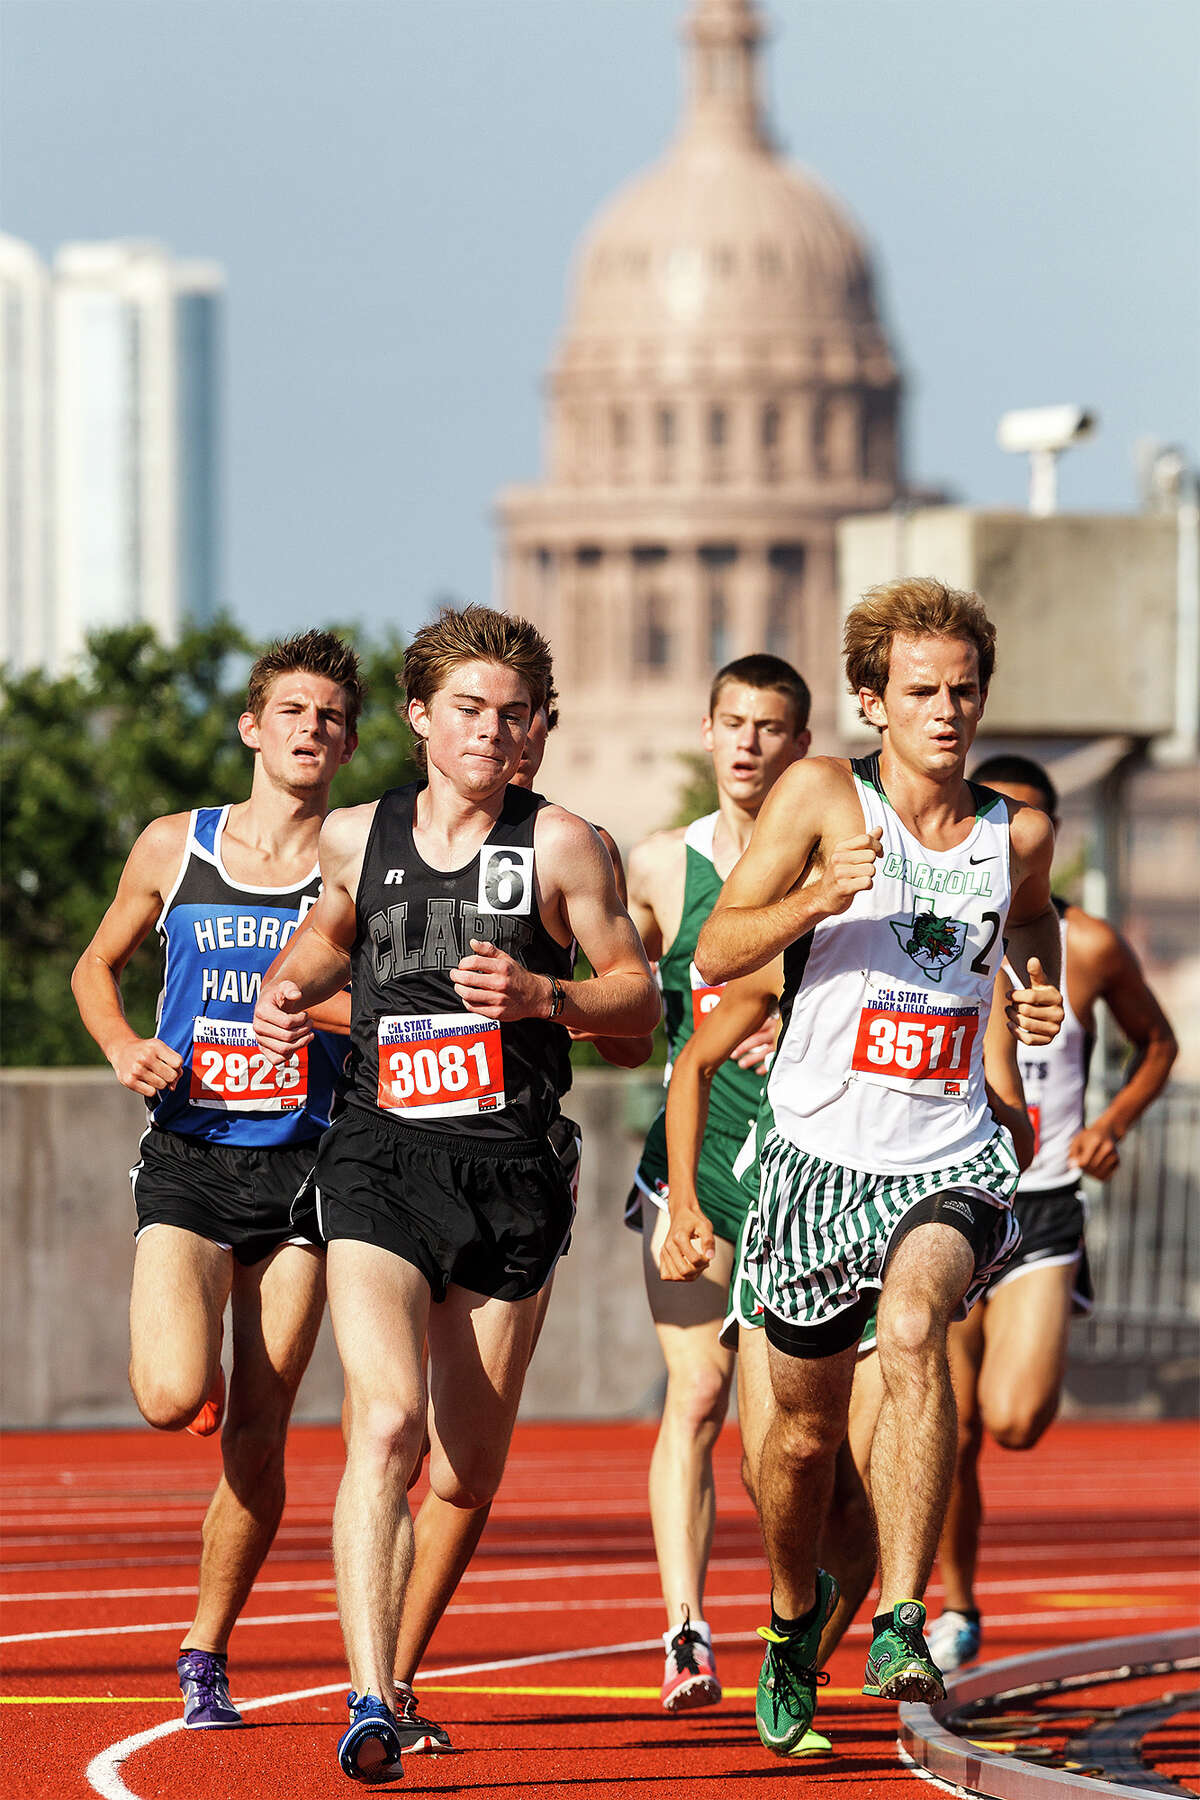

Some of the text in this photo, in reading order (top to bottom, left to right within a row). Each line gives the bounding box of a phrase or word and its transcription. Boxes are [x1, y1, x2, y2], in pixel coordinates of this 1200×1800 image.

[484, 850, 525, 911] 6
[882, 852, 994, 898] CARROLL
[969, 911, 1001, 976] 2
[867, 1000, 895, 1012] TRACK
[903, 1004, 925, 1015] FIELD
[897, 991, 929, 1005] STATE
[197, 1035, 221, 1045] TRACK
[226, 1037, 245, 1047] FIELD
[220, 1027, 247, 1038] STATE
[381, 1034, 406, 1045] TRACK
[411, 1030, 432, 1042] FIELD
[432, 1021, 499, 1040] CHAMPIONSHIPS
[404, 1018, 433, 1033] STATE
[866, 1018, 966, 1070] 3511
[201, 1050, 301, 1093] 2928
[388, 1041, 491, 1099] 3081
